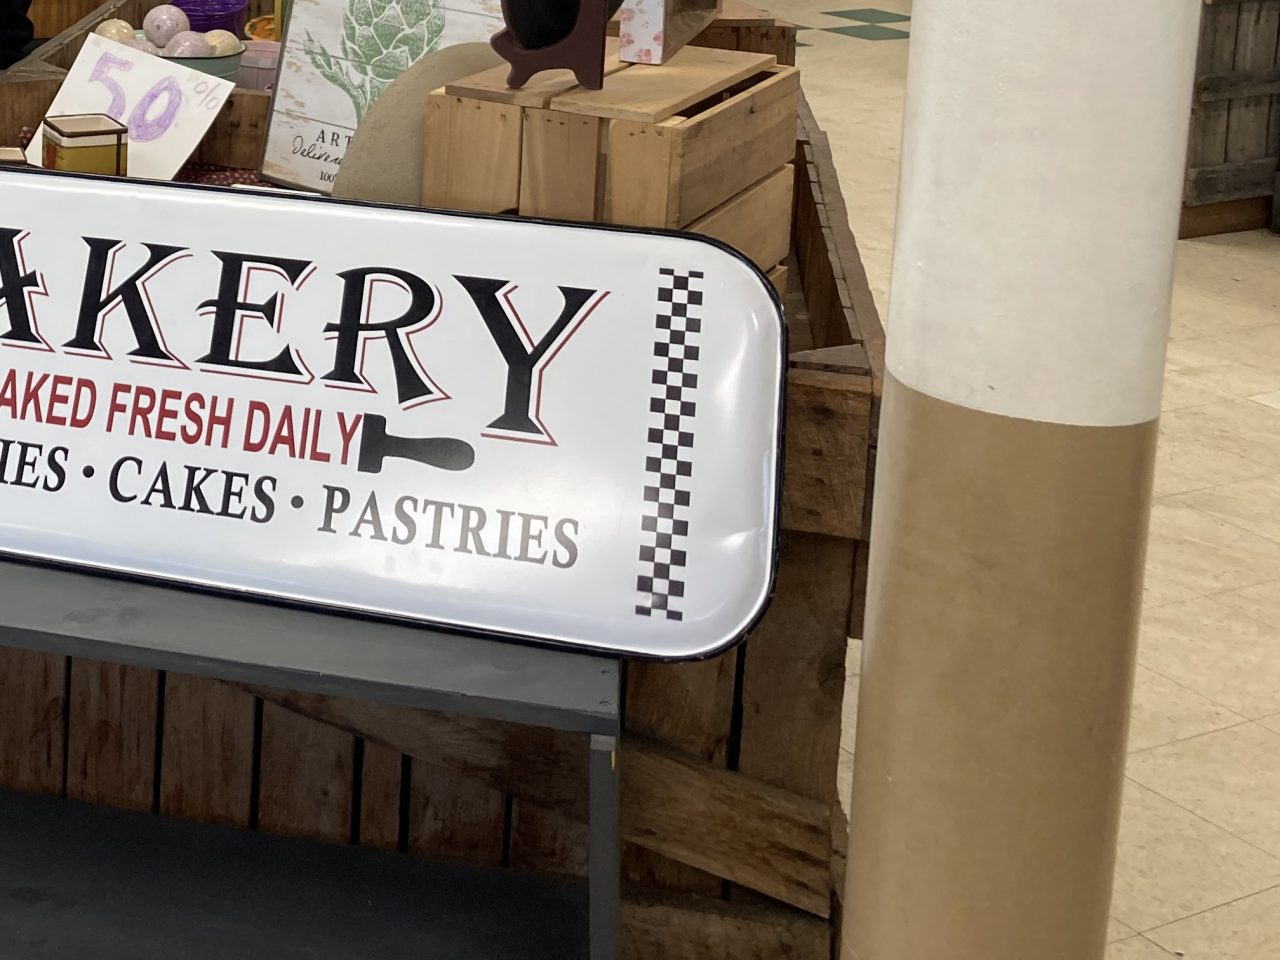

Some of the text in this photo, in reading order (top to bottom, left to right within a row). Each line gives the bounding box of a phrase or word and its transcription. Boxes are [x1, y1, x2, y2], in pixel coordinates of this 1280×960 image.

[106, 382, 233, 449] FRESH
[242, 399, 364, 467] DAILY
[107, 454, 278, 525] CAKES
[321, 484, 581, 570] PASTRIES
